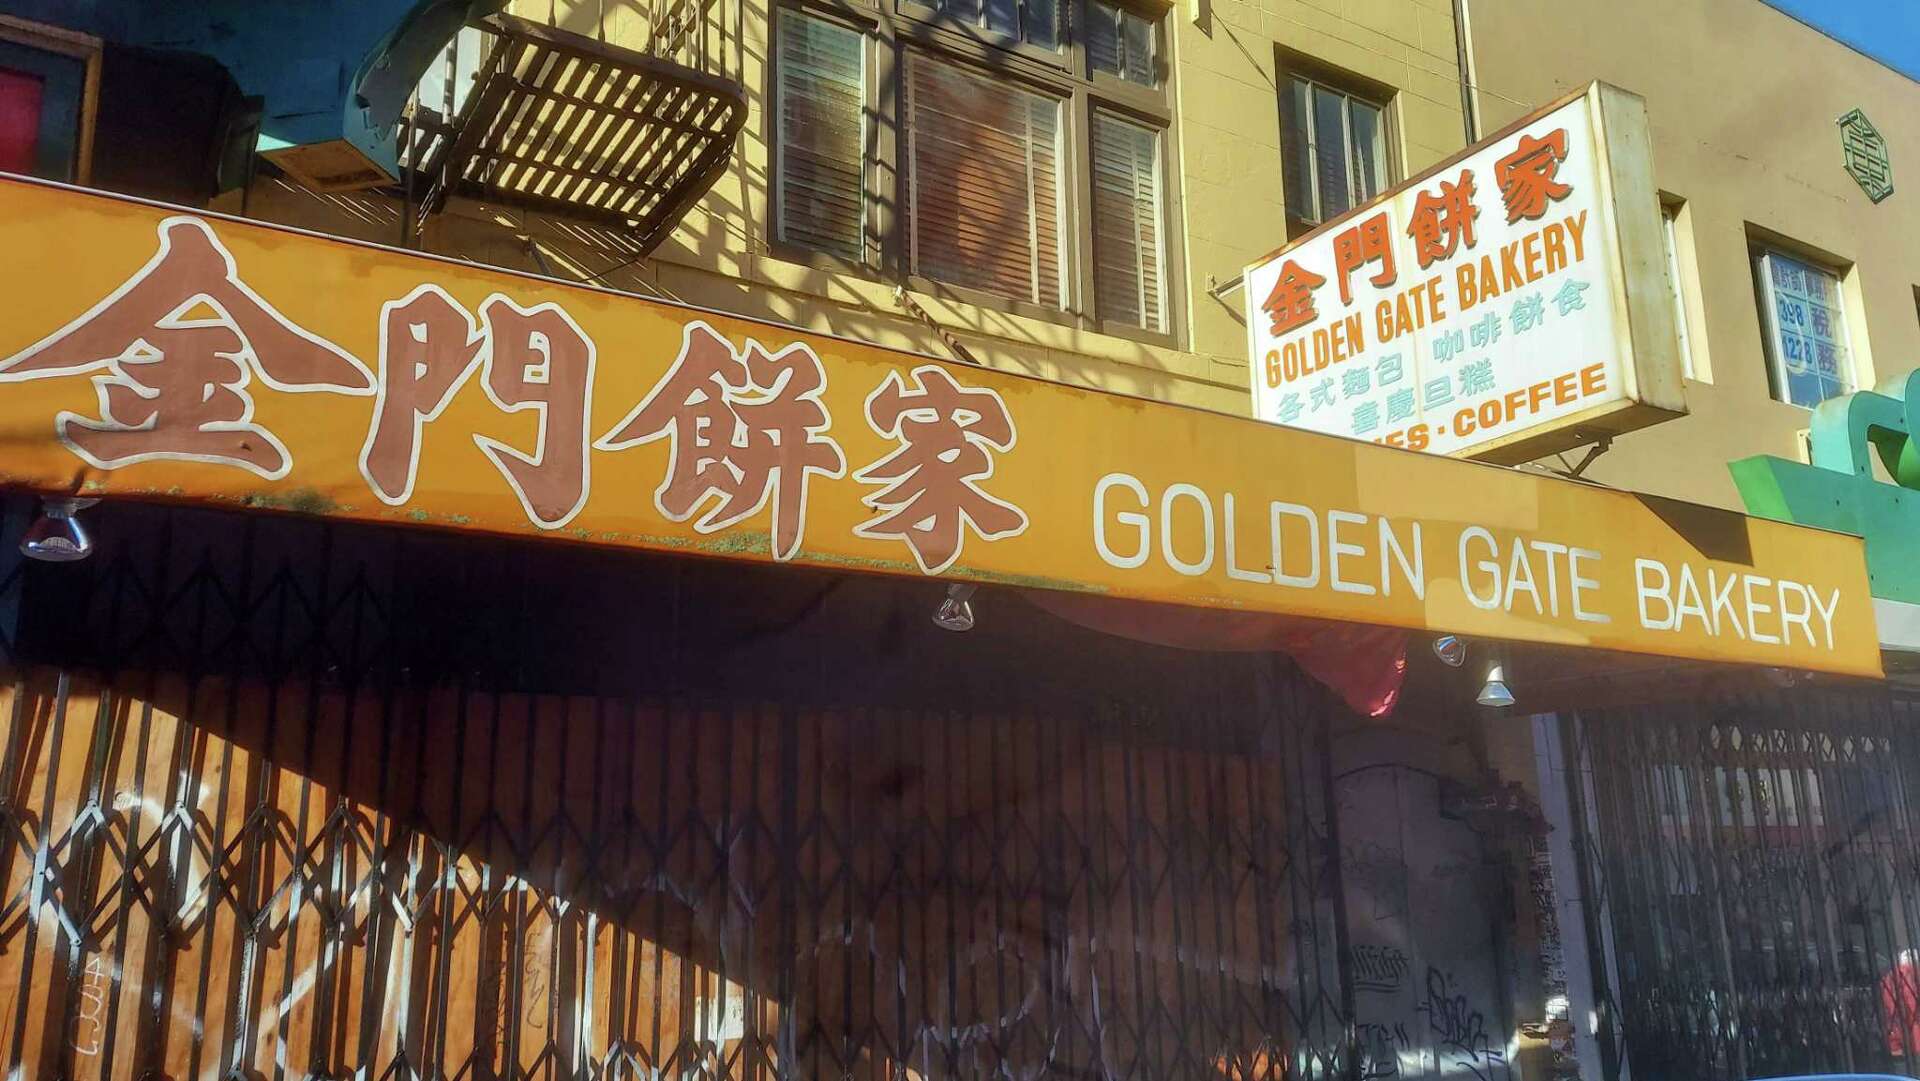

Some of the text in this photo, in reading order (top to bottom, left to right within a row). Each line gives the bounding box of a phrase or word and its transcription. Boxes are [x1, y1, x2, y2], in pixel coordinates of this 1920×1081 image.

[1261, 128, 1574, 338] 金門餅家
[1265, 209, 1588, 389] GOLDEN GATE BAKERY
[1780, 300, 1805, 327] 398
[0, 215, 1030, 576] 金門餅家
[1276, 278, 1590, 423] 各式麵包 咖啡餅食
[1374, 362, 1607, 452] ES COFFEE
[1093, 472, 1840, 650] GOLDEN GATE BAKERY
